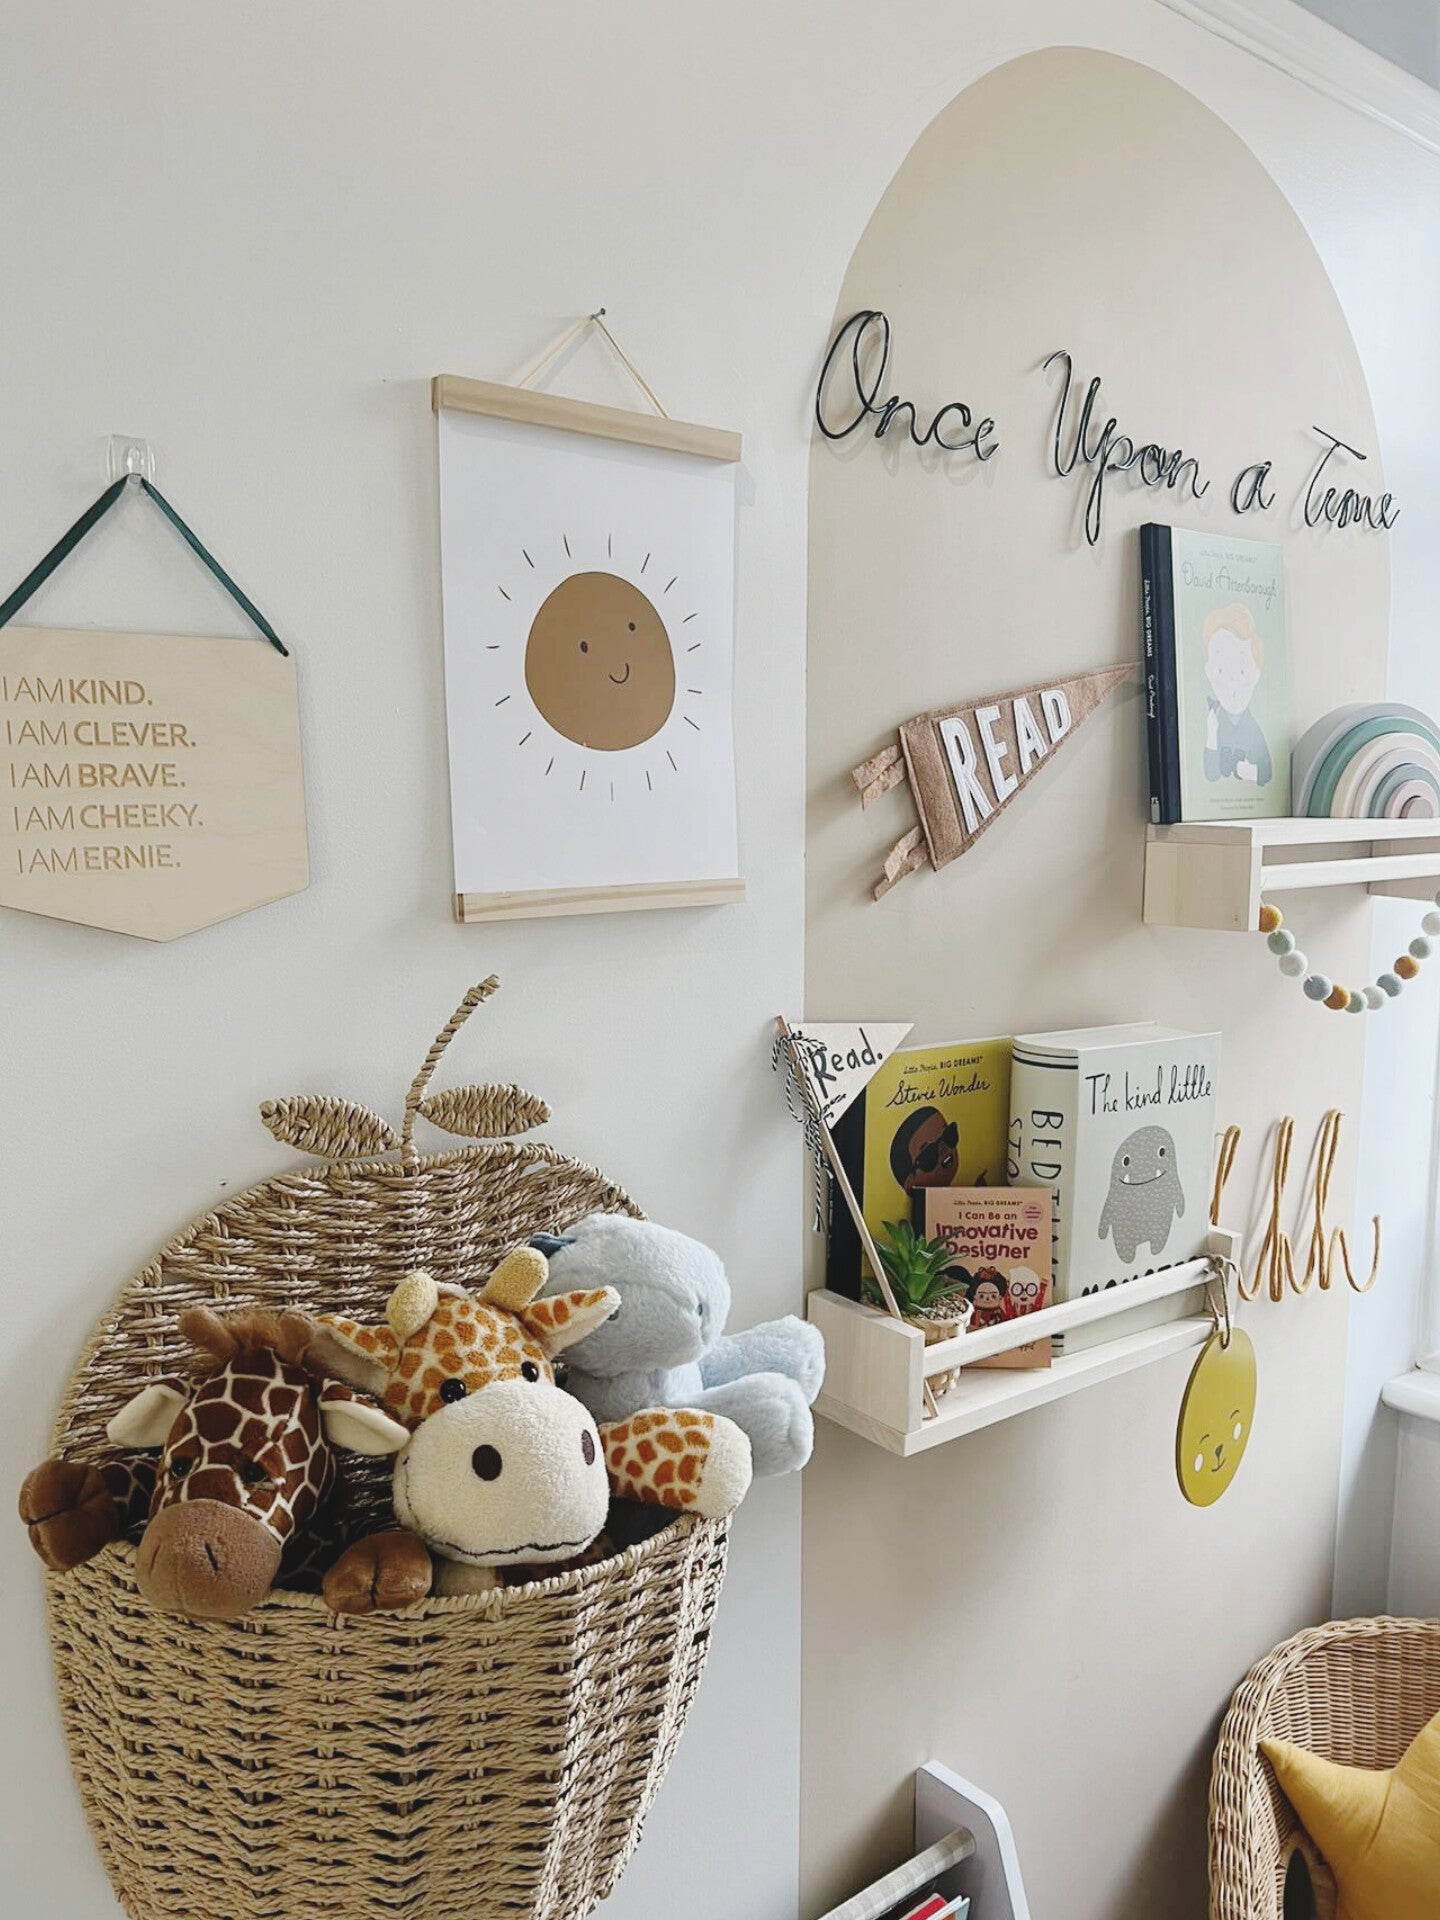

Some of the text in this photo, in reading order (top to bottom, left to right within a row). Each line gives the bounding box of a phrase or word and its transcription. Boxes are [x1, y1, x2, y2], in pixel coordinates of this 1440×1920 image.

[815, 310, 1401, 546] Once Upon a Time
[1181, 561, 1214, 589] David
[2, 676, 153, 706] I AM KIND.
[6, 720, 197, 748] I AM CLEVER.
[10, 763, 186, 789] I AM BRAVE.
[938, 689, 1073, 836] READ
[13, 803, 204, 832] I AM CHEEKY.
[17, 844, 181, 874] I AM ERNIE.
[809, 1027, 883, 1099] Read.
[884, 1071, 991, 1107] Stevie Wonder
[1085, 1064, 1212, 1115] The kind little
[958, 1211, 962, 1220] I
[965, 1211, 985, 1220] Can
[988, 1211, 1001, 1220] Be
[1003, 1212, 1018, 1220] an
[935, 1223, 1039, 1241] Innovative
[945, 1240, 1031, 1261] Designer
